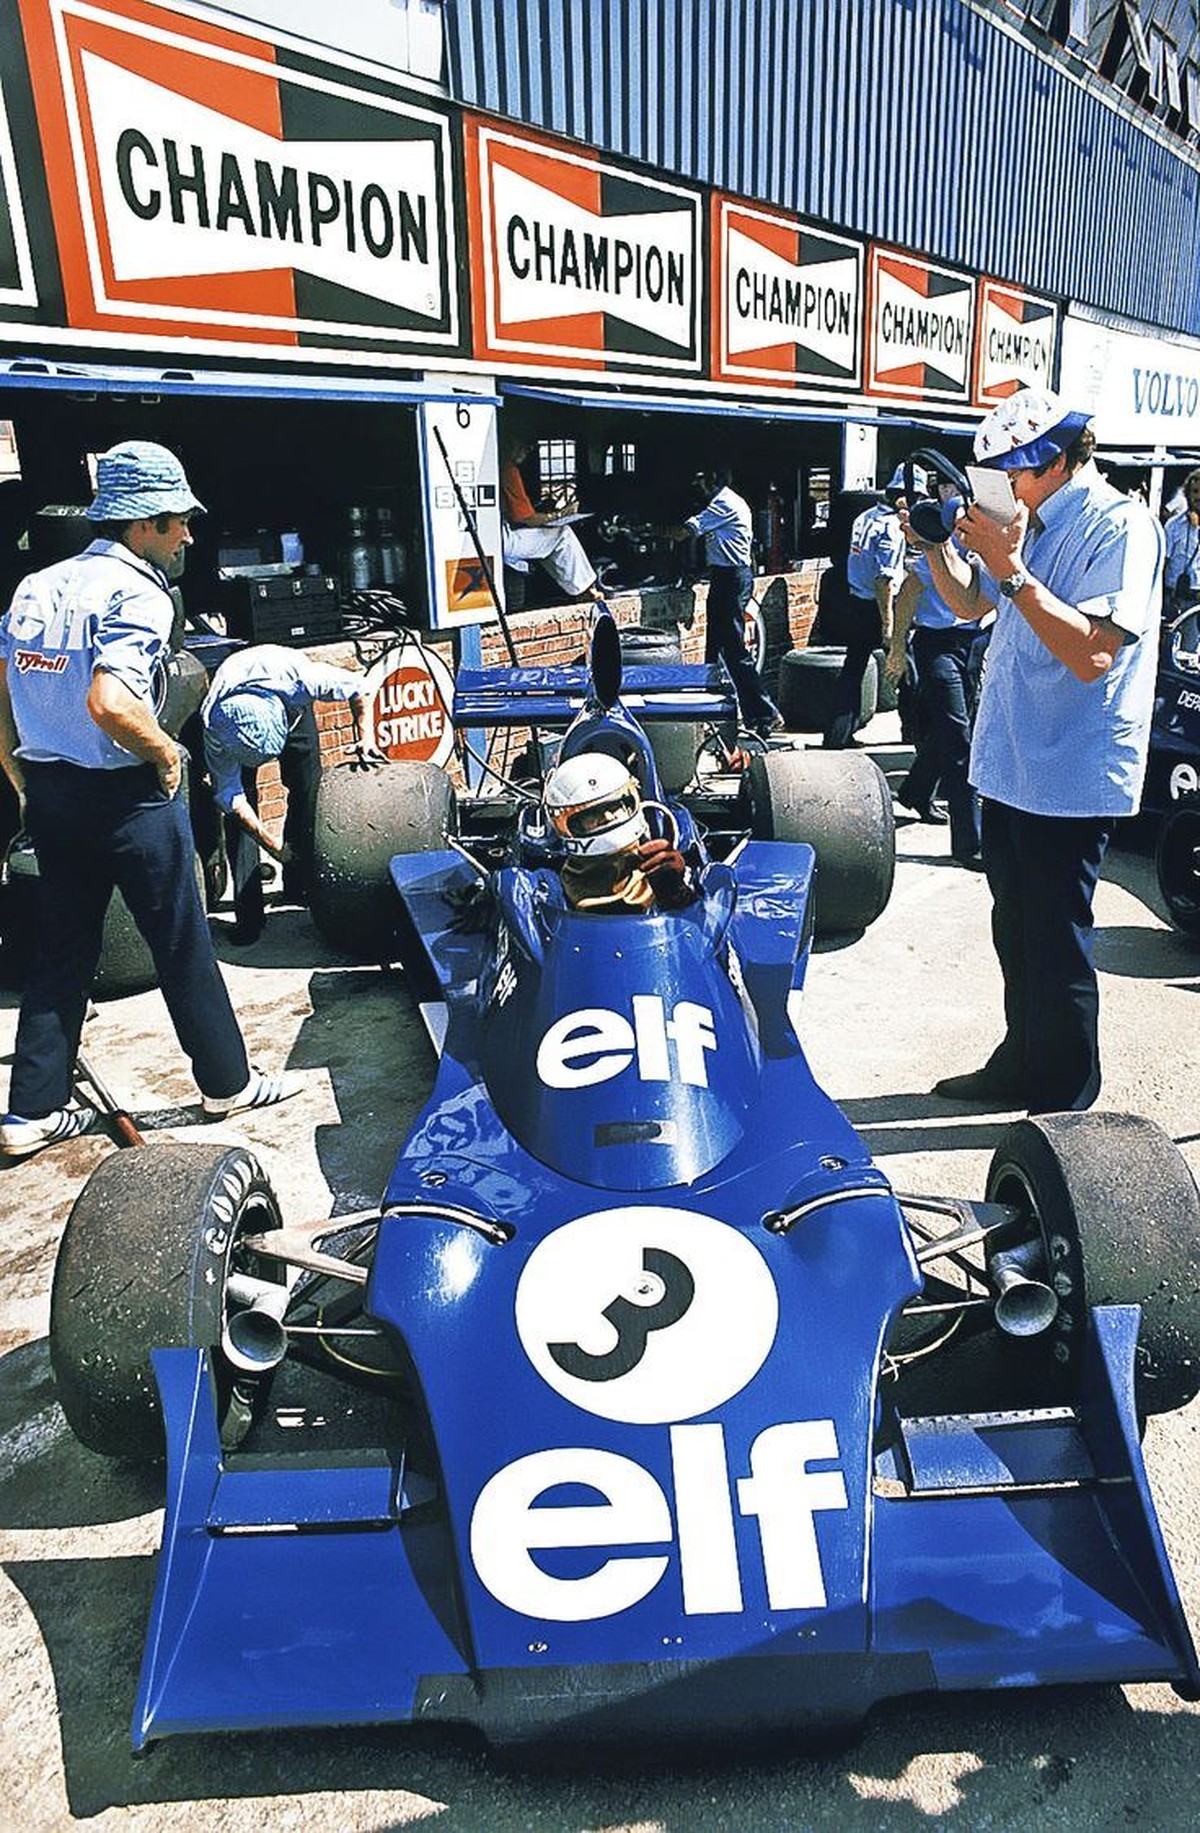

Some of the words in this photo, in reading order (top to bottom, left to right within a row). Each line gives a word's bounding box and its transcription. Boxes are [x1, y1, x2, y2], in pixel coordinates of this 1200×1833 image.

[116, 128, 428, 265] CHAMPION
[507, 214, 685, 306] CHAMPION
[736, 267, 851, 336] CHAMPION
[882, 304, 964, 355] CHAMPION
[989, 327, 1046, 371] CHAMPION
[456, 402, 471, 429] 6
[1133, 368, 1198, 417] VOLVO
[379, 680, 435, 715] LUCKY
[377, 709, 443, 748] STRIKE
[536, 994, 716, 1090] elf
[547, 1247, 695, 1382] 3
[470, 1419, 848, 1622] elf
